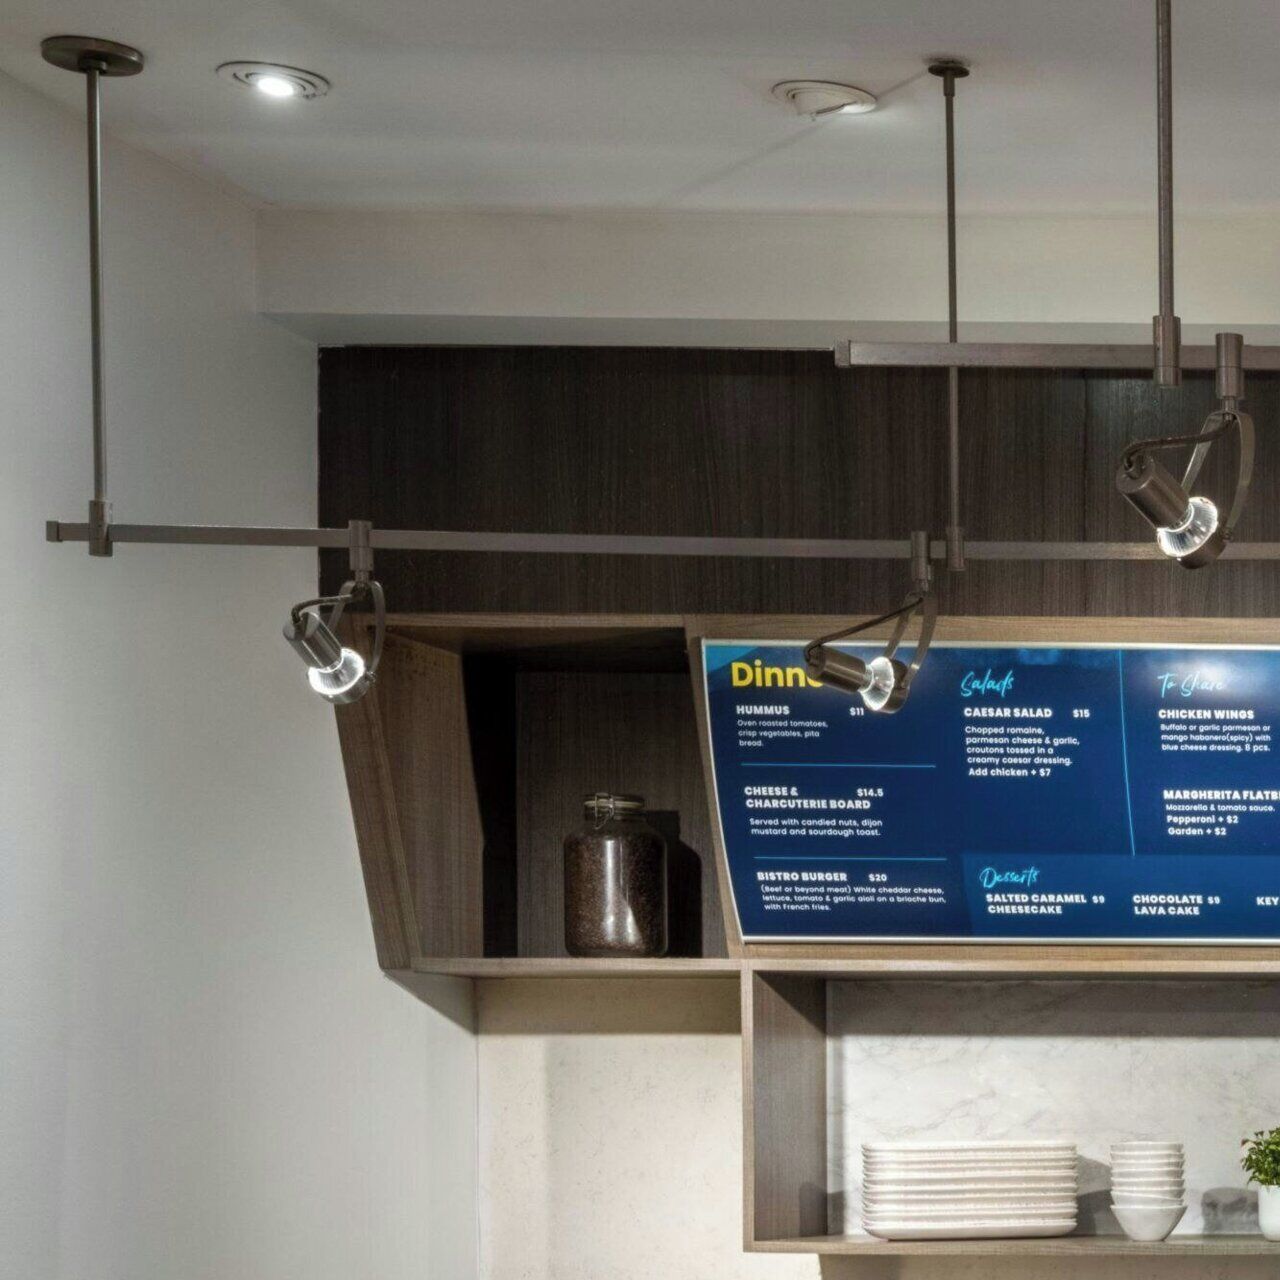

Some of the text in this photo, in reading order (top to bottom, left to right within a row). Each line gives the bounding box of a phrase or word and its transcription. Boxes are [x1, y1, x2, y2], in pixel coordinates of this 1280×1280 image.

[731, 659, 823, 688] Dinn
[961, 669, 1014, 697] Salads
[1157, 671, 1225, 698] To Share
[736, 704, 864, 717] HUMMUS $11
[964, 707, 1090, 718] CAESAR SALAD $15
[1159, 709, 1211, 720] CHICKEN
[1214, 709, 1254, 720] WINGS
[965, 725, 1044, 737] Chopped romaine,
[744, 785, 883, 798] CHEESE & $14.5
[1163, 790, 1241, 801] MARGHERITA
[746, 798, 871, 810] CHARCUTERIE BOARD
[757, 871, 887, 883] BISTRO BURGER $20
[979, 866, 1040, 889] Desserts
[986, 892, 1087, 904] SALTED CARAMEL
[1133, 893, 1203, 905] CHOCOLATE
[1256, 896, 1279, 907] KEY
[988, 904, 1062, 916] CHEESECAKE
[1134, 905, 1199, 916] LAVA CAKE
